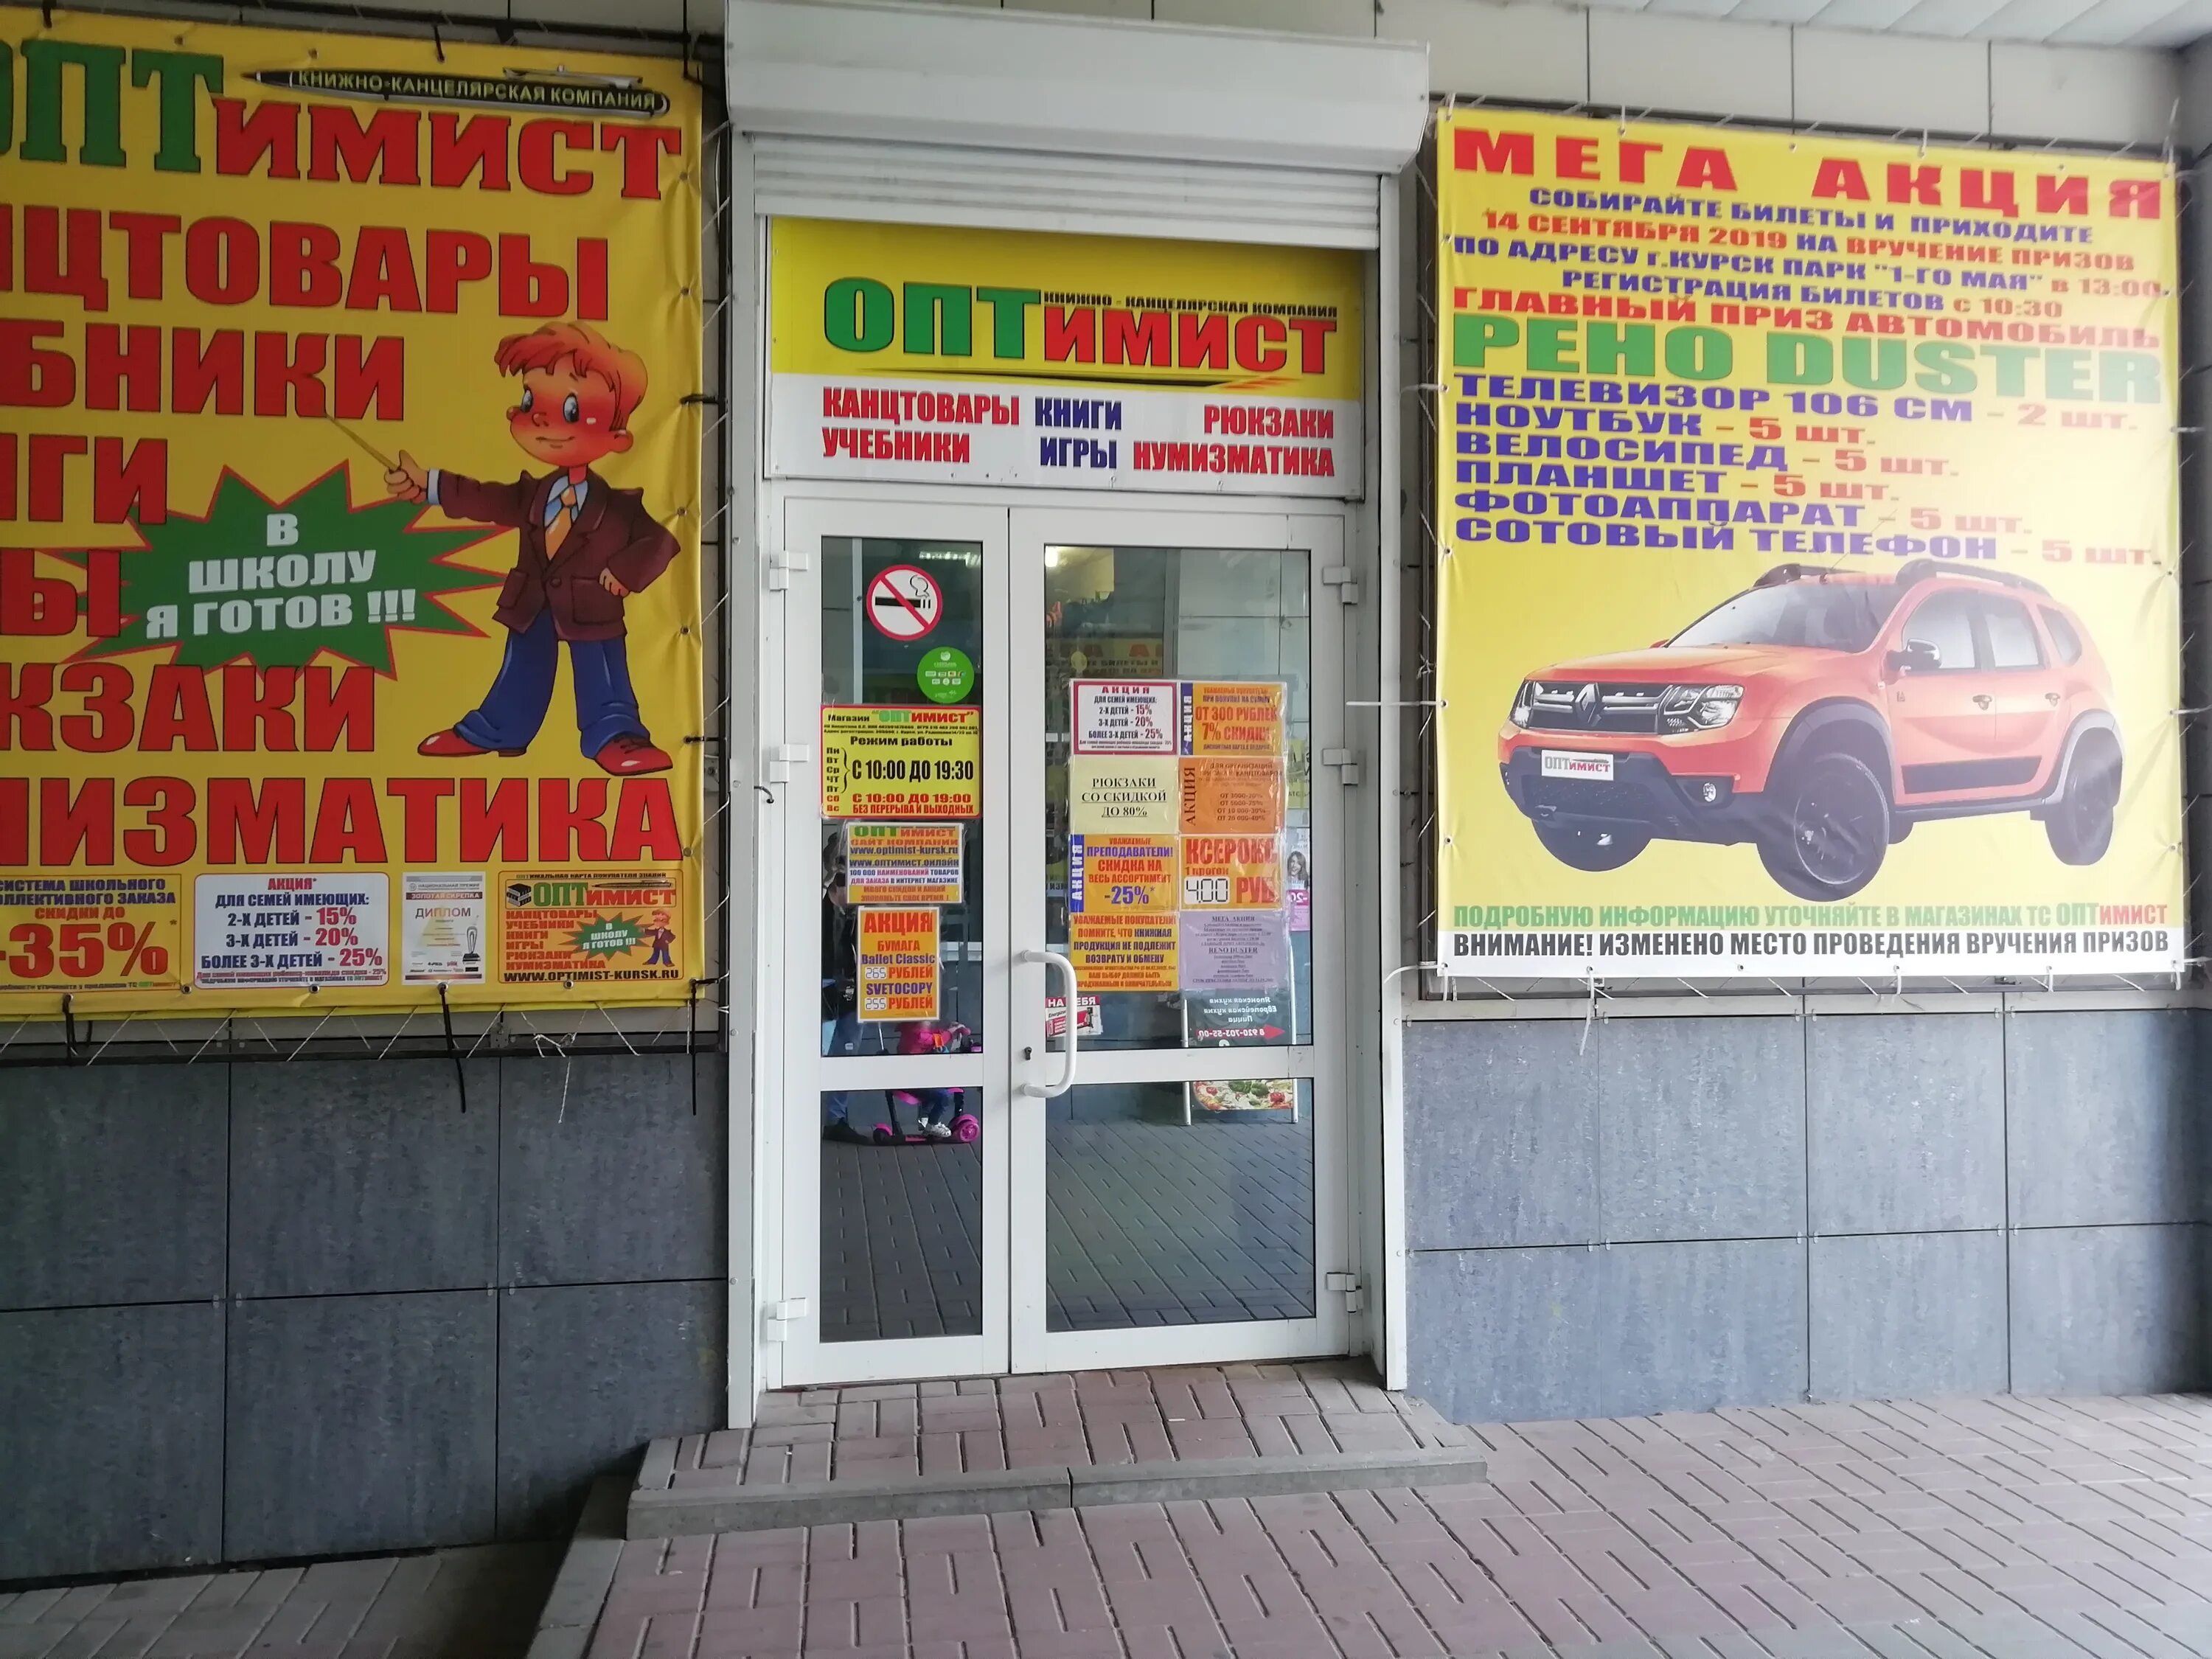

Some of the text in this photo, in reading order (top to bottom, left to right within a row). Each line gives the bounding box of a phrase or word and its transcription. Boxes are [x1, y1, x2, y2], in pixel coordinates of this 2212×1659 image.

[296, 69, 656, 111] КНИЖНО-КАНЦЕЛЯРСКАЯ КОМПАНИЯ
[0, 38, 682, 201] ПТимист
[1454, 127, 2161, 220] МЕГА АКЦИЯ
[1530, 187, 2093, 244] СОБИРАЙТЕ БИЛЕТЫ И ПРИХОДИТЕ
[1485, 209, 2135, 271] 14 СЕНТЯБРЯ 2019 НА ВРУЧЕНИЕ ПРИЗОВ
[0, 203, 608, 321] ЦТОВАРЫ
[1454, 236, 1499, 256] ПО
[1508, 238, 1638, 264] АДРЕСУ
[1784, 258, 1866, 282] ПАРК
[2081, 278, 2162, 297] 13:00
[1044, 291, 1338, 319] КНИЖНО КАНЦЕЛЯРСКАЯ КОМПАНИЯ
[1562, 270, 1795, 302] РЕГИСТРАЦИЯ
[1801, 285, 1944, 311] БИЛЕТОВ
[1979, 296, 2062, 318] 10:30
[1454, 287, 2160, 348] ГЛАВНЫЙ ПРИЗ АВТОМОБИЛЬ
[1454, 313, 2162, 404] РЕНО DUSTER
[1454, 372, 1770, 411] ТЕЛЕВИЗОР
[1783, 392, 1879, 417] 106
[1893, 397, 1973, 422] СМ
[2017, 403, 2047, 426] 2
[823, 386, 1334, 439] КАНЦТОВАРЫ КНИГИ РЮКЗАКИ
[1456, 402, 1875, 445] НОУТБУК 5 шт.
[823, 428, 1335, 477] УЧЕБНИКИ ИГРЫ НУМИЗМАТИКА
[1456, 431, 1958, 476] ВЕЛОСИПЕД 5 шт.
[1456, 459, 1899, 501] ПЛАНШЕТ 5 шт.
[1455, 489, 2033, 534] ФОТОАППАРАТ 5 шт.
[267, 513, 299, 547] В
[1456, 518, 1734, 551] СОТОВЫЙ
[1750, 529, 1997, 560] ТЕЛЕФОН
[2042, 540, 2072, 564] 5
[189, 549, 377, 594] ШКОЛУ
[146, 589, 416, 639] Я ГОТОВ !!!
[828, 714, 869, 722] Магазин
[1195, 706, 1209, 720] ОТ
[1212, 706, 1233, 720] 300
[850, 736, 952, 745] Режим работы
[1202, 722, 1220, 740] 7%
[852, 759, 973, 782] С 10:00 ДО 19:30
[1093, 778, 1155, 787] РЮКЗАКИ
[866, 793, 904, 802] 10:00
[908, 793, 928, 803] ДО
[934, 793, 970, 802] 19:00
[1082, 790, 1166, 802] СО СКИДКОЙ
[1184, 768, 1195, 825] АКЦИЯ
[853, 804, 867, 813] БЕЗ
[871, 804, 916, 813] ПЕРЕРЫВА
[924, 804, 973, 814] ВЫХОДНЫХ
[1102, 807, 1147, 817] ДО 80%
[850, 846, 958, 855] www.optimist-kursk.ru
[1087, 846, 1172, 858] ПРЕПОДАВАТЕЛИ!
[1186, 838, 1278, 863] КСЕРОКС
[1072, 844, 1082, 900] АКЦИЯ
[1098, 859, 1162, 872] СКИДКА НА
[1088, 874, 1170, 883] ВЕСЬ АССОРТИМЕНТ
[215, 894, 246, 910] ДЛЯ
[248, 893, 292, 907] СЕМЕЙ
[35, 906, 125, 921] СКИДКИ ДО
[254, 910, 300, 928] ДЕТЕЙ
[316, 907, 357, 925] 15%
[415, 907, 471, 921] ДИПЛОМ
[864, 912, 933, 935] АКЦИЯ
[1454, 905, 1594, 930] ПОДРОБНУЮ
[1599, 905, 1760, 930] ИНФОРМАЦИЮ
[1765, 902, 1882, 927] УТОЧНЯЙТЕ
[1886, 906, 1899, 927] В
[1905, 905, 2023, 927] МАГАЗИНАХ
[2026, 905, 2051, 926] ТС
[252, 931, 298, 949] ДЕТЕЙ
[316, 928, 358, 947] 20%
[1118, 928, 1133, 937] ЧТО
[1134, 928, 1171, 936] КНИЖНАЯ
[877, 940, 919, 950] БУМАГА
[1074, 942, 1120, 950] ПРОДУКЦИЯ
[1133, 942, 1175, 950] ПОДЛЕЖИТ
[1454, 931, 2168, 959] ВНИМАНИЕ! ИЗМЕНЕНО МЕСТО ПРОВЕДЕНИЯ ВРУЧЕНИЯ ПРИЗОВ
[201, 955, 248, 970] БОЛЕЕ
[277, 950, 322, 970] ДЕТЕЙ
[340, 947, 383, 967] 25%
[862, 953, 934, 964] Ballet Classic
[504, 970, 680, 983] WWW.OPTIMIST-KURSK.RU
[866, 964, 932, 978] 265 РУБЛЕЙ
[866, 982, 932, 995] SVETOCOPY
[865, 995, 932, 1009] 255 РУБЛЕЙ
[1048, 997, 1096, 1007] НА ЕБЯ
